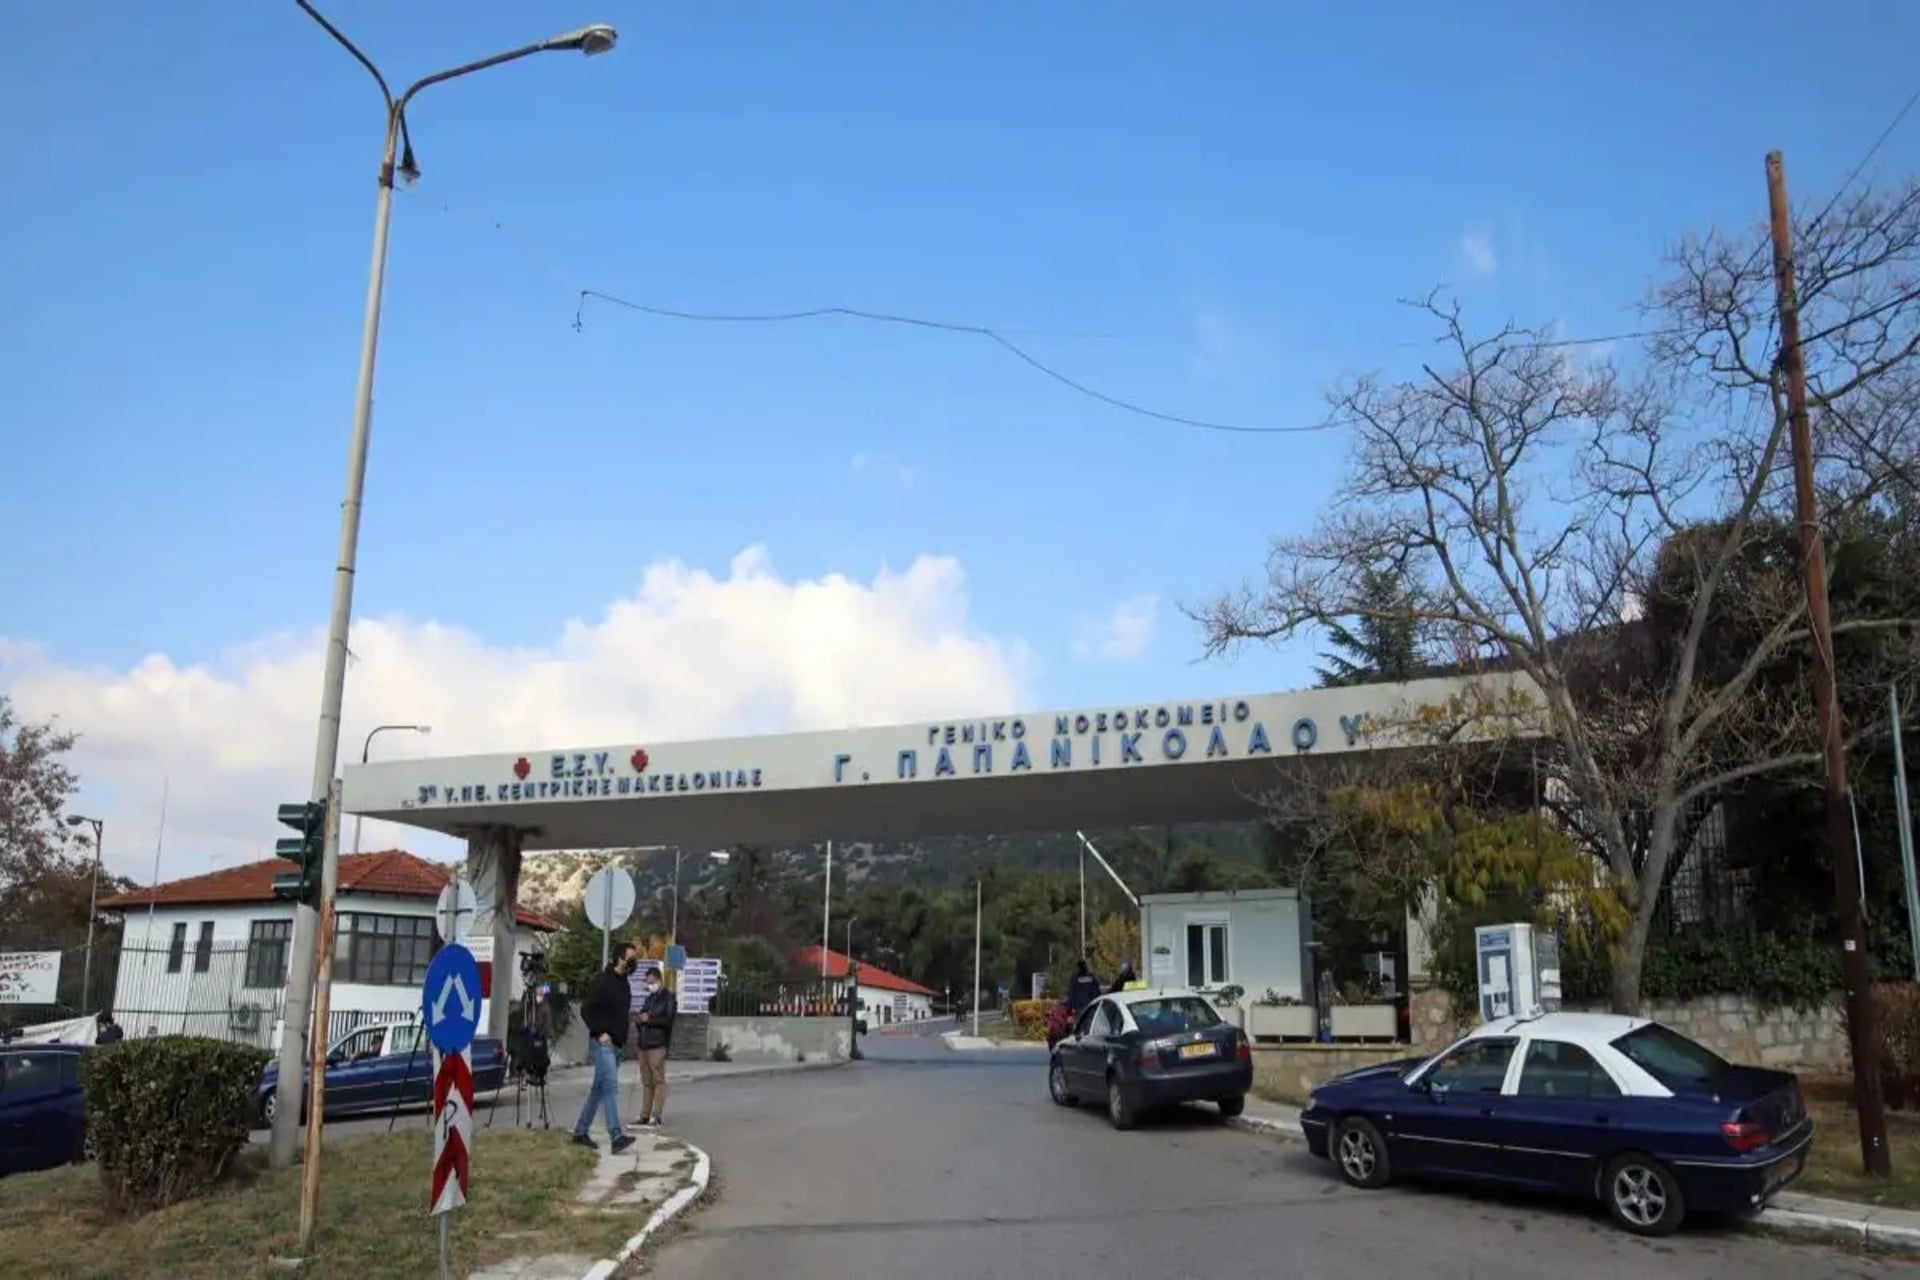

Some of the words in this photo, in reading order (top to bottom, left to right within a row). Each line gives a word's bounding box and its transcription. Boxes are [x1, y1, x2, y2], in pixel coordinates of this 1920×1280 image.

[928, 718, 1026, 746] ΓΕΝΙΚΟ
[1055, 700, 1250, 736] ΝΟΣΟΚΟΜΕΙΟ
[551, 751, 615, 778] Ε.Σ.Υ.
[834, 753, 870, 783] Γ.
[897, 713, 1363, 779] ΠΑΠΑΝΙΚΟΛΑΟΥ
[498, 778, 611, 801] ΚΕΝΤΡΙΚΗΣ
[617, 768, 762, 794] ΜΑΚΕΔΟΝΙΑΣ
